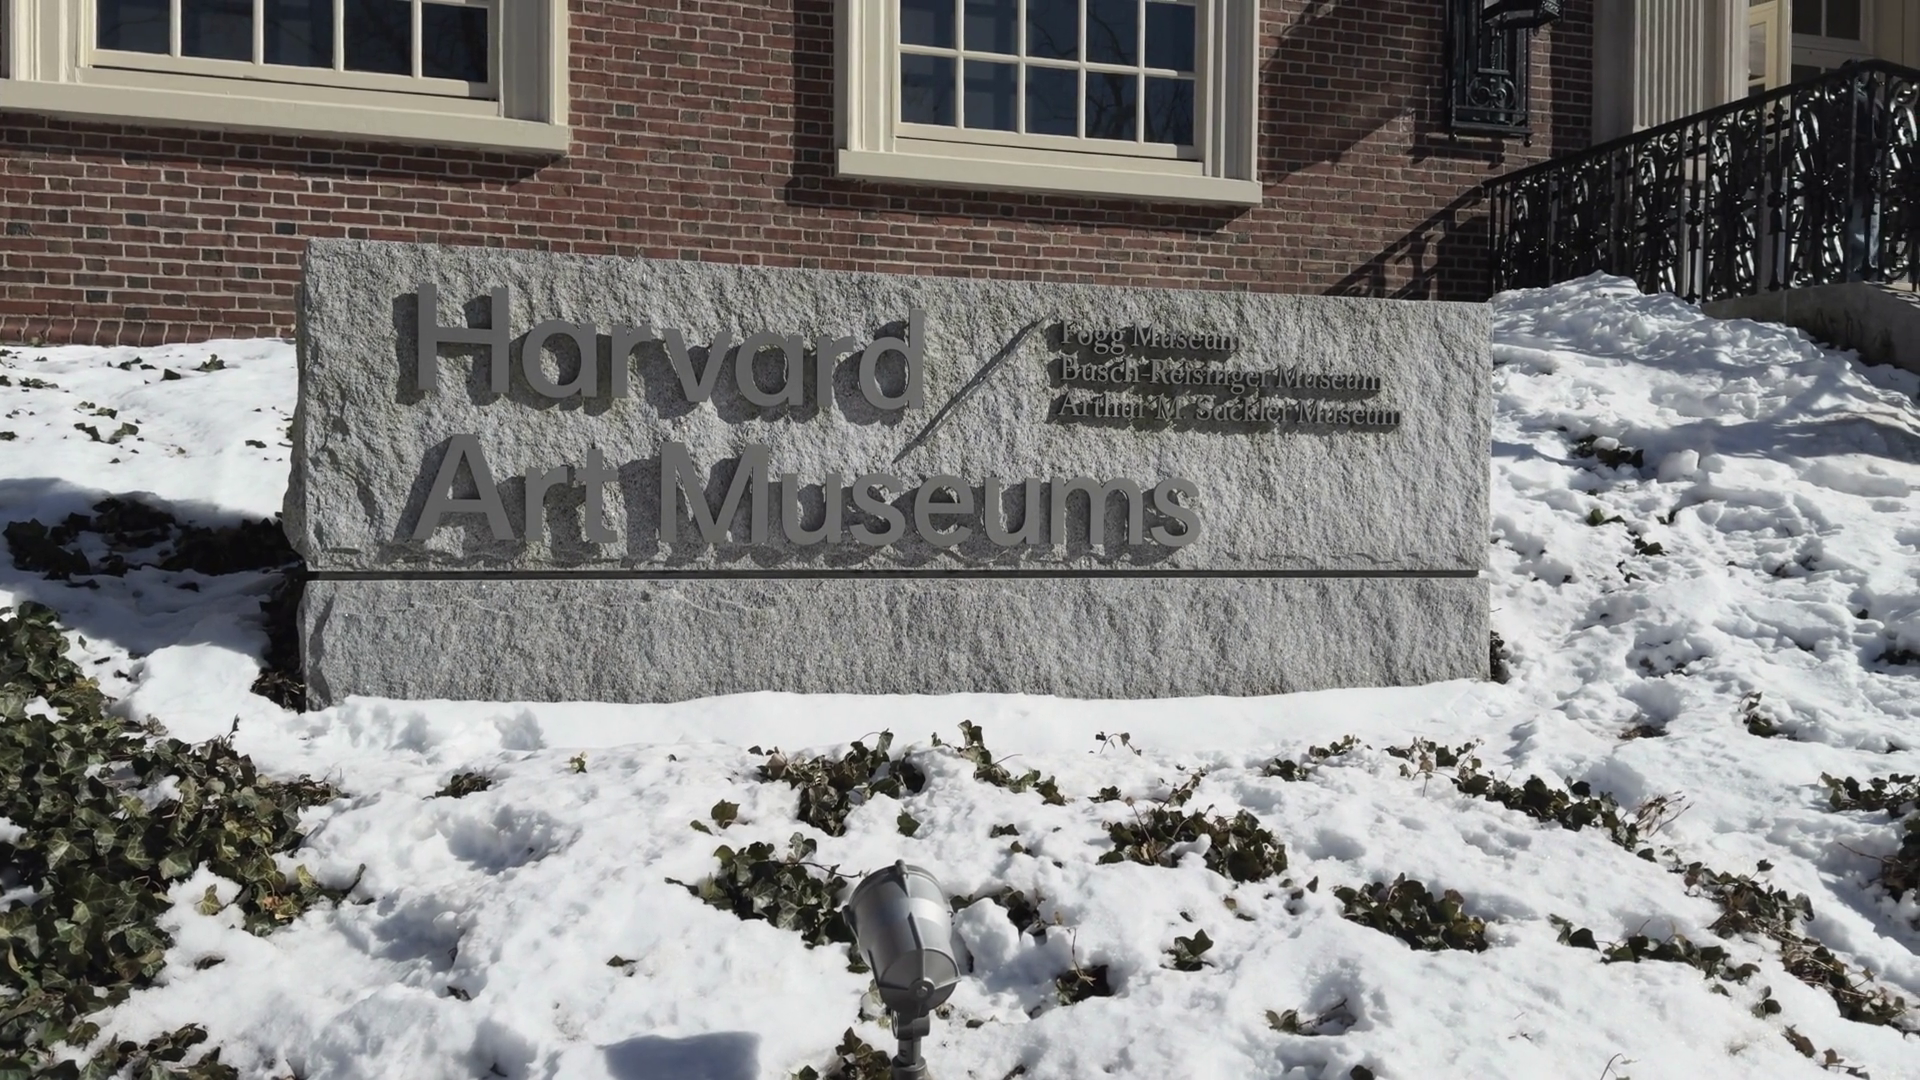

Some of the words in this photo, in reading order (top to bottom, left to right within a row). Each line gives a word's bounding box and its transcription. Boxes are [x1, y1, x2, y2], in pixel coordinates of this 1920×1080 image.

[417, 283, 925, 410] Harvard
[1061, 320, 1125, 354] Fogg
[1133, 322, 1240, 352] Museum
[1061, 358, 1271, 394] Busch-Reisinger
[1276, 365, 1382, 391] Museum
[1059, 394, 1146, 420] Arthur
[1156, 397, 1186, 421] M.
[1196, 398, 1292, 424] Sackler
[1298, 403, 1400, 426] Museum
[413, 433, 619, 544] Art
[660, 442, 1200, 547] Museums
